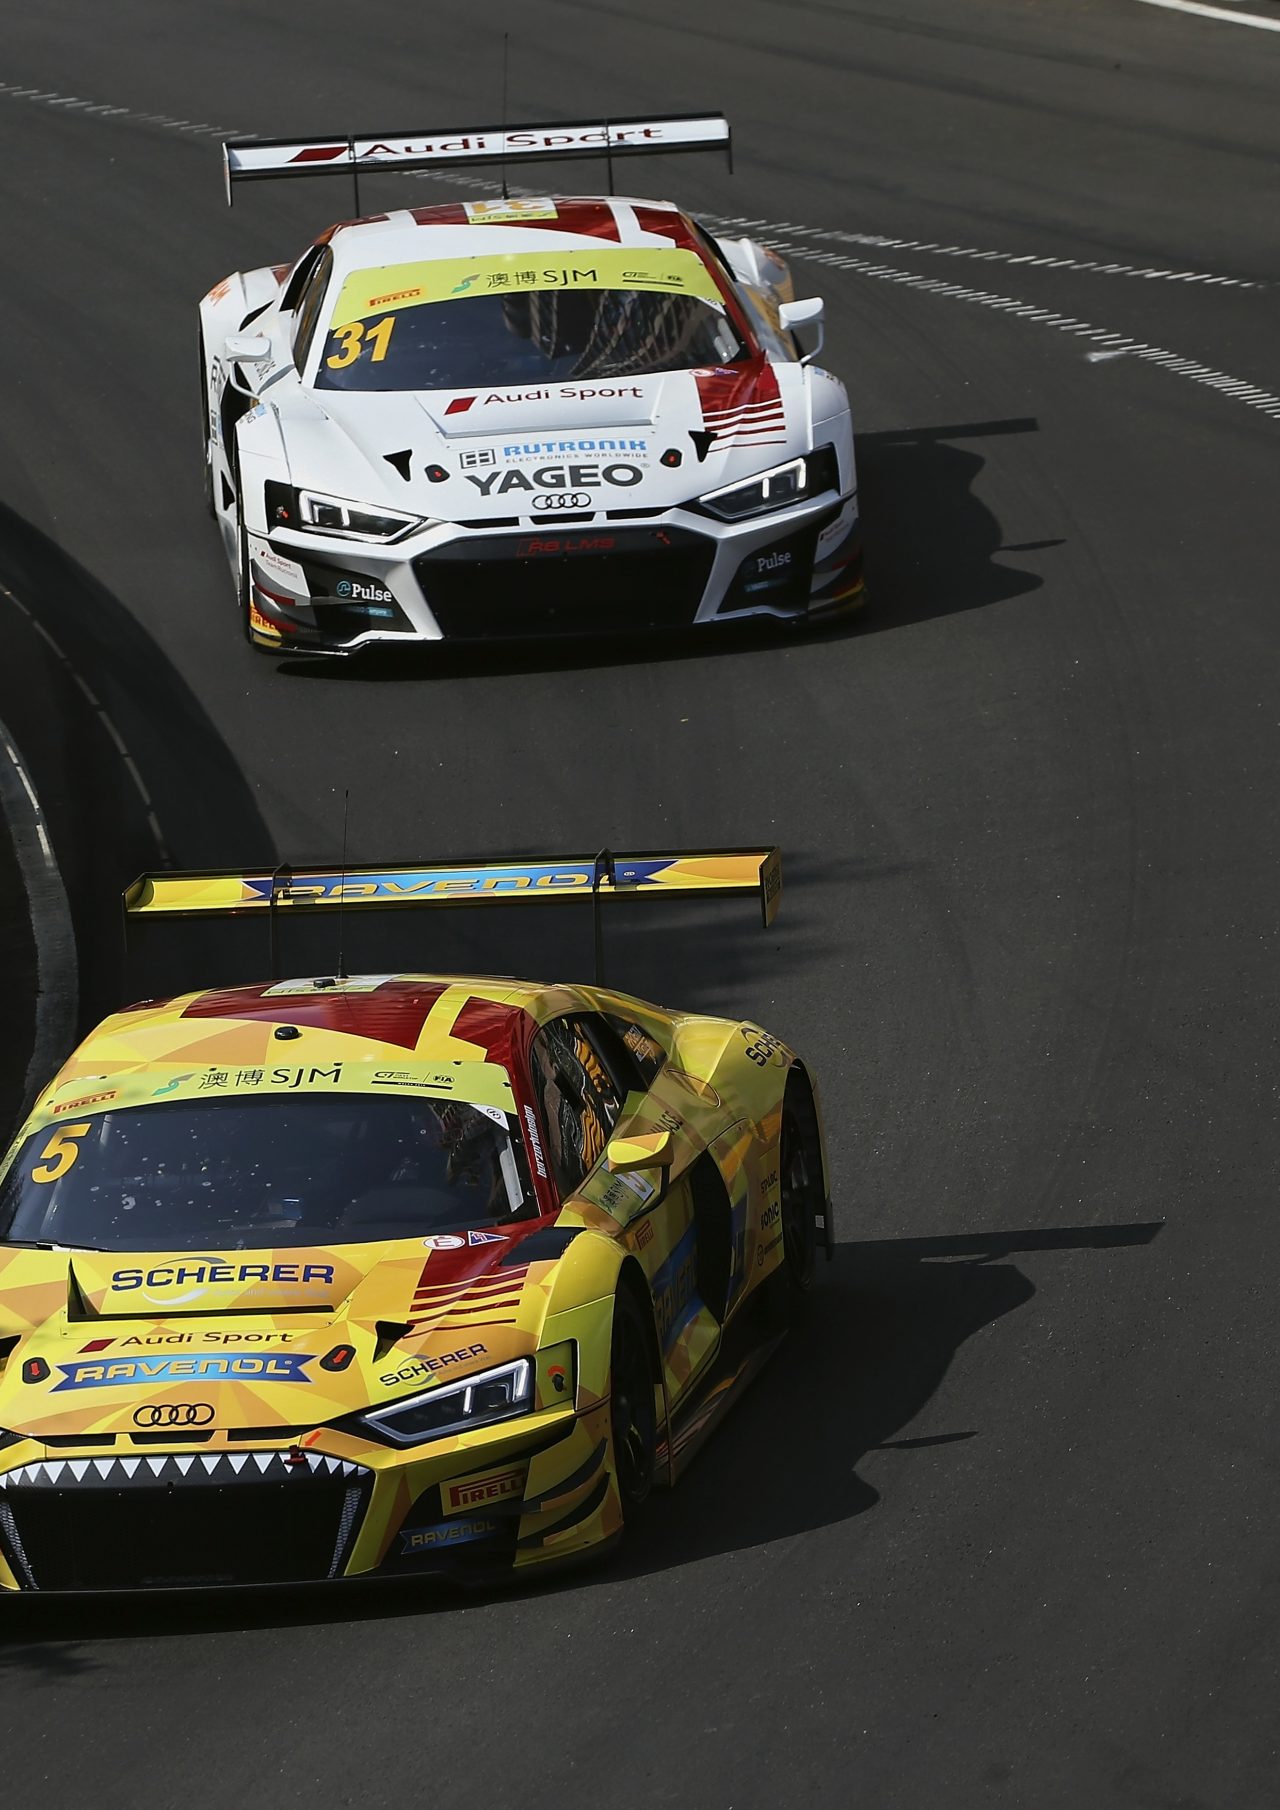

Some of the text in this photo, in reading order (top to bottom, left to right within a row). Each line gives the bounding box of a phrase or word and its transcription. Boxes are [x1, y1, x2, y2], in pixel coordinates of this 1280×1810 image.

[363, 128, 664, 158] Audi Sport
[487, 269, 598, 288] 澳博 SJM
[369, 288, 421, 307] PIRELLI
[326, 316, 396, 370] 31
[483, 386, 644, 405] Audi Sport
[503, 439, 648, 457] RUTRONIK
[505, 452, 649, 464] ELECTRONICS WORLDWIDE
[464, 463, 644, 497] YAGEO
[756, 551, 792, 573] Pulse
[351, 583, 392, 602] Pulse
[198, 1067, 344, 1090] 澳博 SJM
[432, 1075, 455, 1083] FIA
[53, 1090, 117, 1114] PIRELLI
[31, 1122, 92, 1185] 5
[111, 1264, 335, 1292] SCHERER
[120, 1331, 294, 1347] Audi Sport
[74, 1358, 291, 1384] RAVENOL
[380, 1343, 488, 1387] SCHERER
[411, 1519, 497, 1547] RAVENOL
